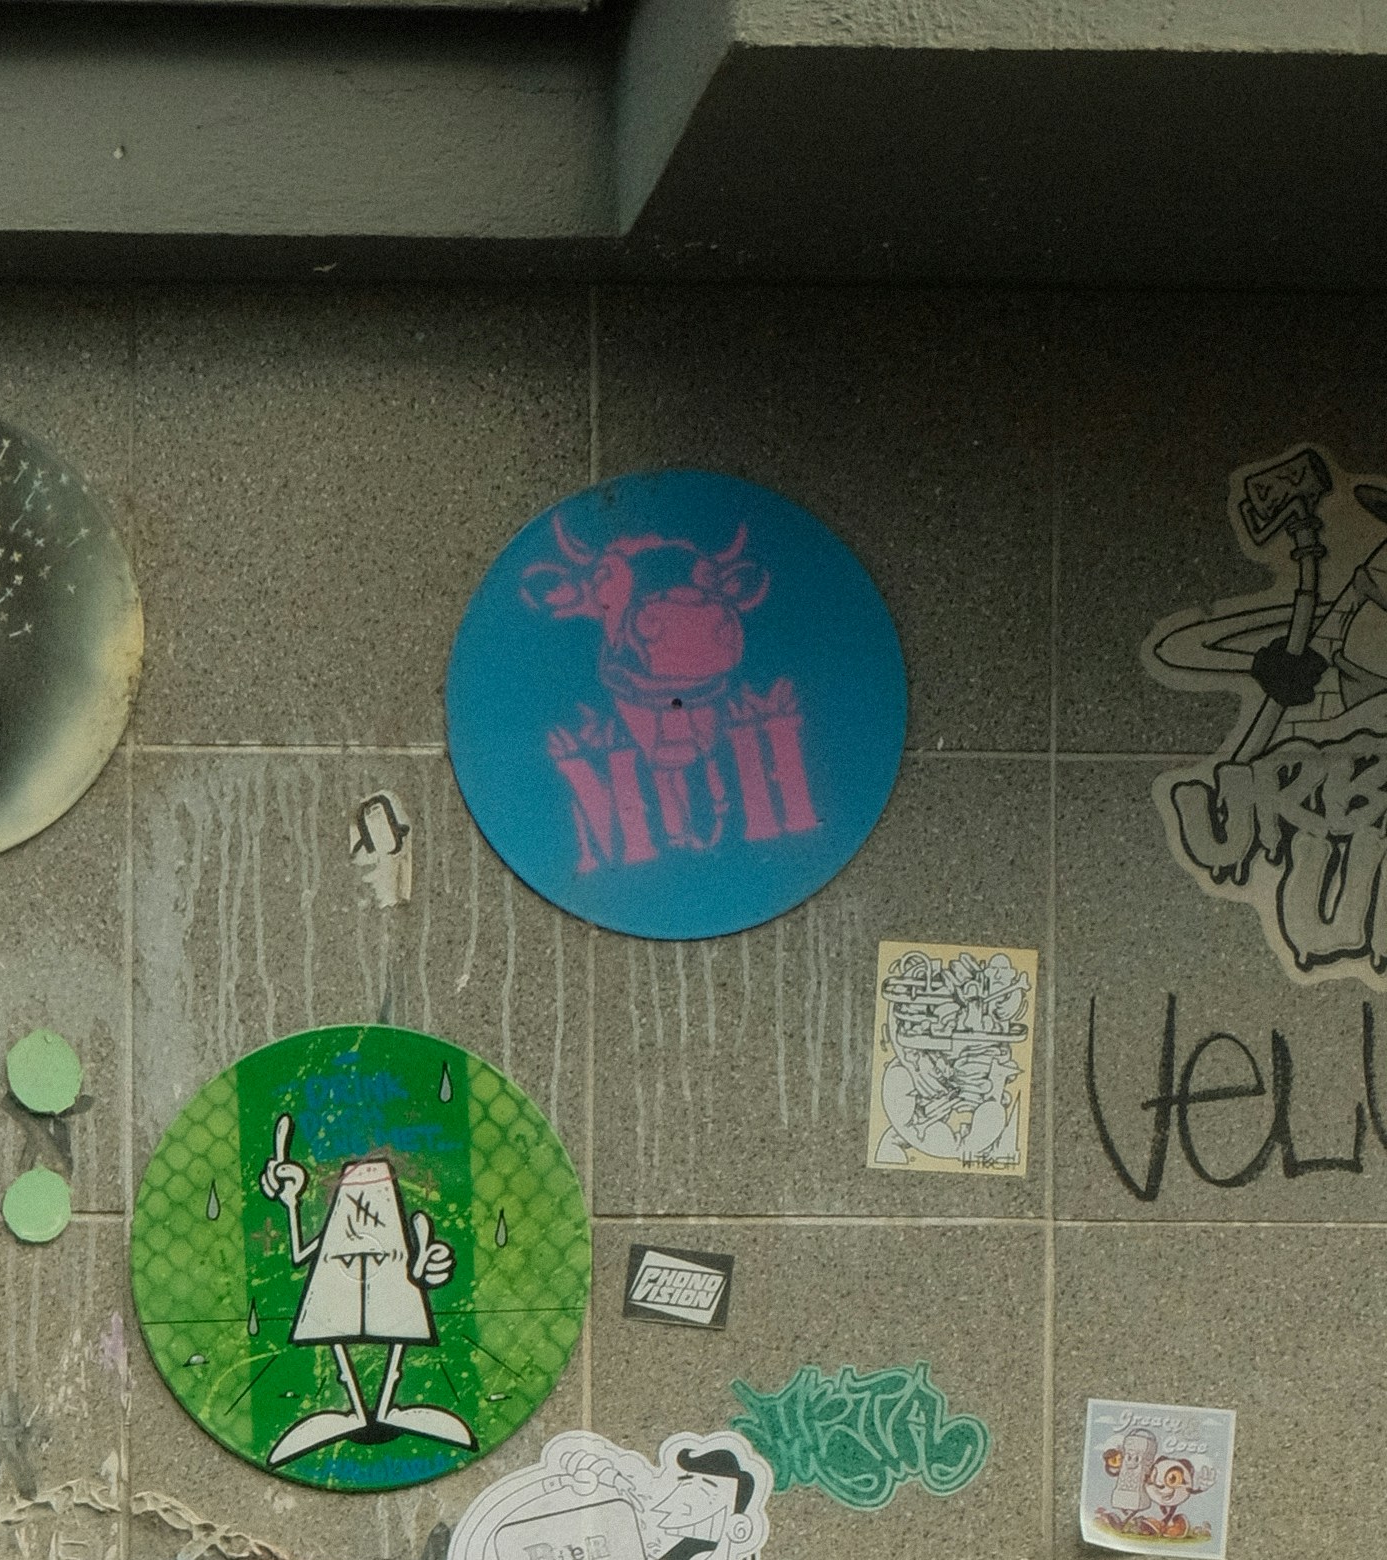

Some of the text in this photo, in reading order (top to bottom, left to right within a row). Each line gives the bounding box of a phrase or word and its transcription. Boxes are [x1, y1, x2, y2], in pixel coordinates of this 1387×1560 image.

[549, 711, 817, 874] MUH
[639, 1265, 723, 1294] PHONO
[632, 1283, 716, 1311] VISION
